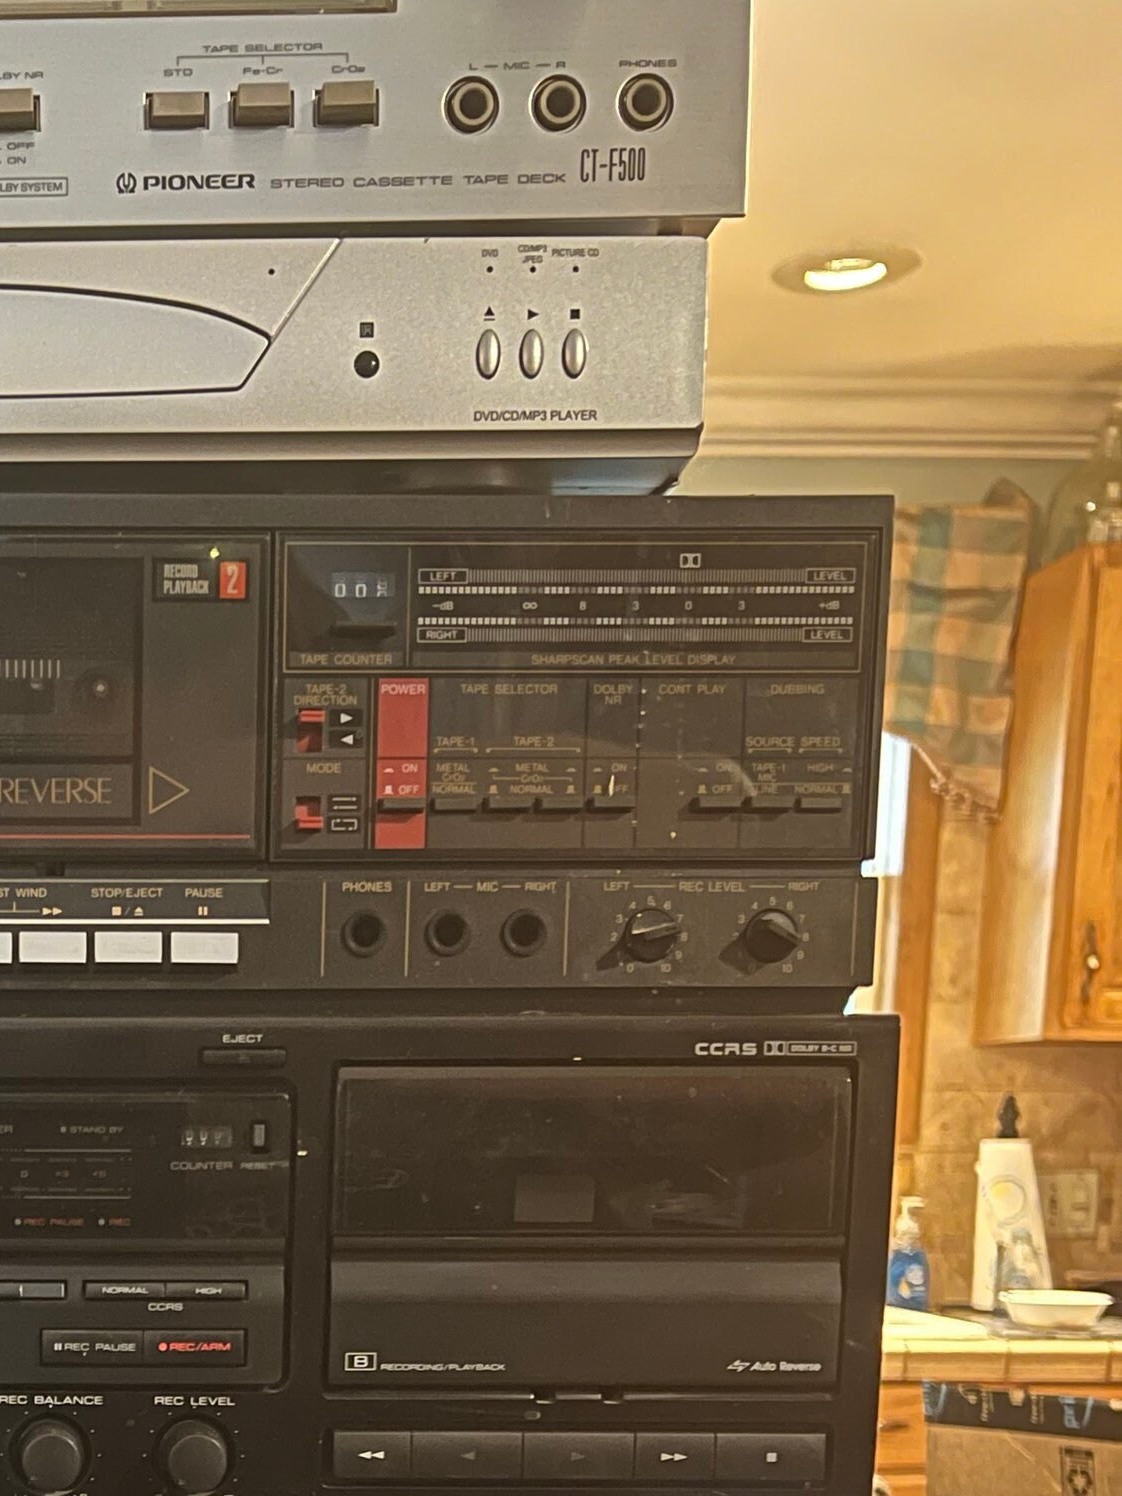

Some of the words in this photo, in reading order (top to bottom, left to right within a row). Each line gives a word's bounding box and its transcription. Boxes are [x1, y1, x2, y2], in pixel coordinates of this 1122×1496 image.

[618, 58, 678, 69] PHONES
[6, 140, 35, 152] OFF
[6, 155, 27, 166] ON
[579, 147, 646, 184] CT-F500
[22, 180, 64, 194] SYSTEM
[142, 173, 255, 191] PIONEER
[270, 176, 346, 190] STEREO
[351, 175, 454, 189] CASSETTE
[462, 174, 509, 188] TAPE
[516, 172, 567, 186] DECK
[473, 410, 548, 422] DVD/CD/MP3
[549, 409, 598, 421] PLAYER
[164, 564, 198, 578] RECORD
[429, 570, 457, 582] LEFT
[812, 570, 847, 582] LEVEL
[227, 566, 238, 594] 2
[163, 580, 209, 595] PLAYBACK
[298, 653, 330, 665] TAPE
[333, 653, 393, 665] COUNTER
[530, 654, 605, 666] SHARPSCAN
[608, 654, 640, 666] PEAK
[643, 653, 683, 666] LEVEL
[686, 653, 736, 666] DISPLAY
[380, 683, 427, 696] POWER
[460, 683, 492, 696] TAPE
[495, 683, 558, 696] SELECTOR
[305, 762, 342, 775] MODE
[398, 784, 420, 795] OFF
[15, 887, 48, 899] WIND
[90, 887, 164, 899] STOP/EJECT
[184, 887, 224, 899] PAUSE
[341, 881, 393, 893] PHONES
[603, 881, 631, 893] LEFT
[678, 881, 705, 893] REC
[706, 881, 746, 893] LEVEL
[788, 881, 820, 892] RIGHT
[222, 1033, 264, 1044] EJECT
[34, 1395, 104, 1406] BALANCE
[153, 1395, 186, 1406] REC
[189, 1395, 236, 1406] LEVEL
